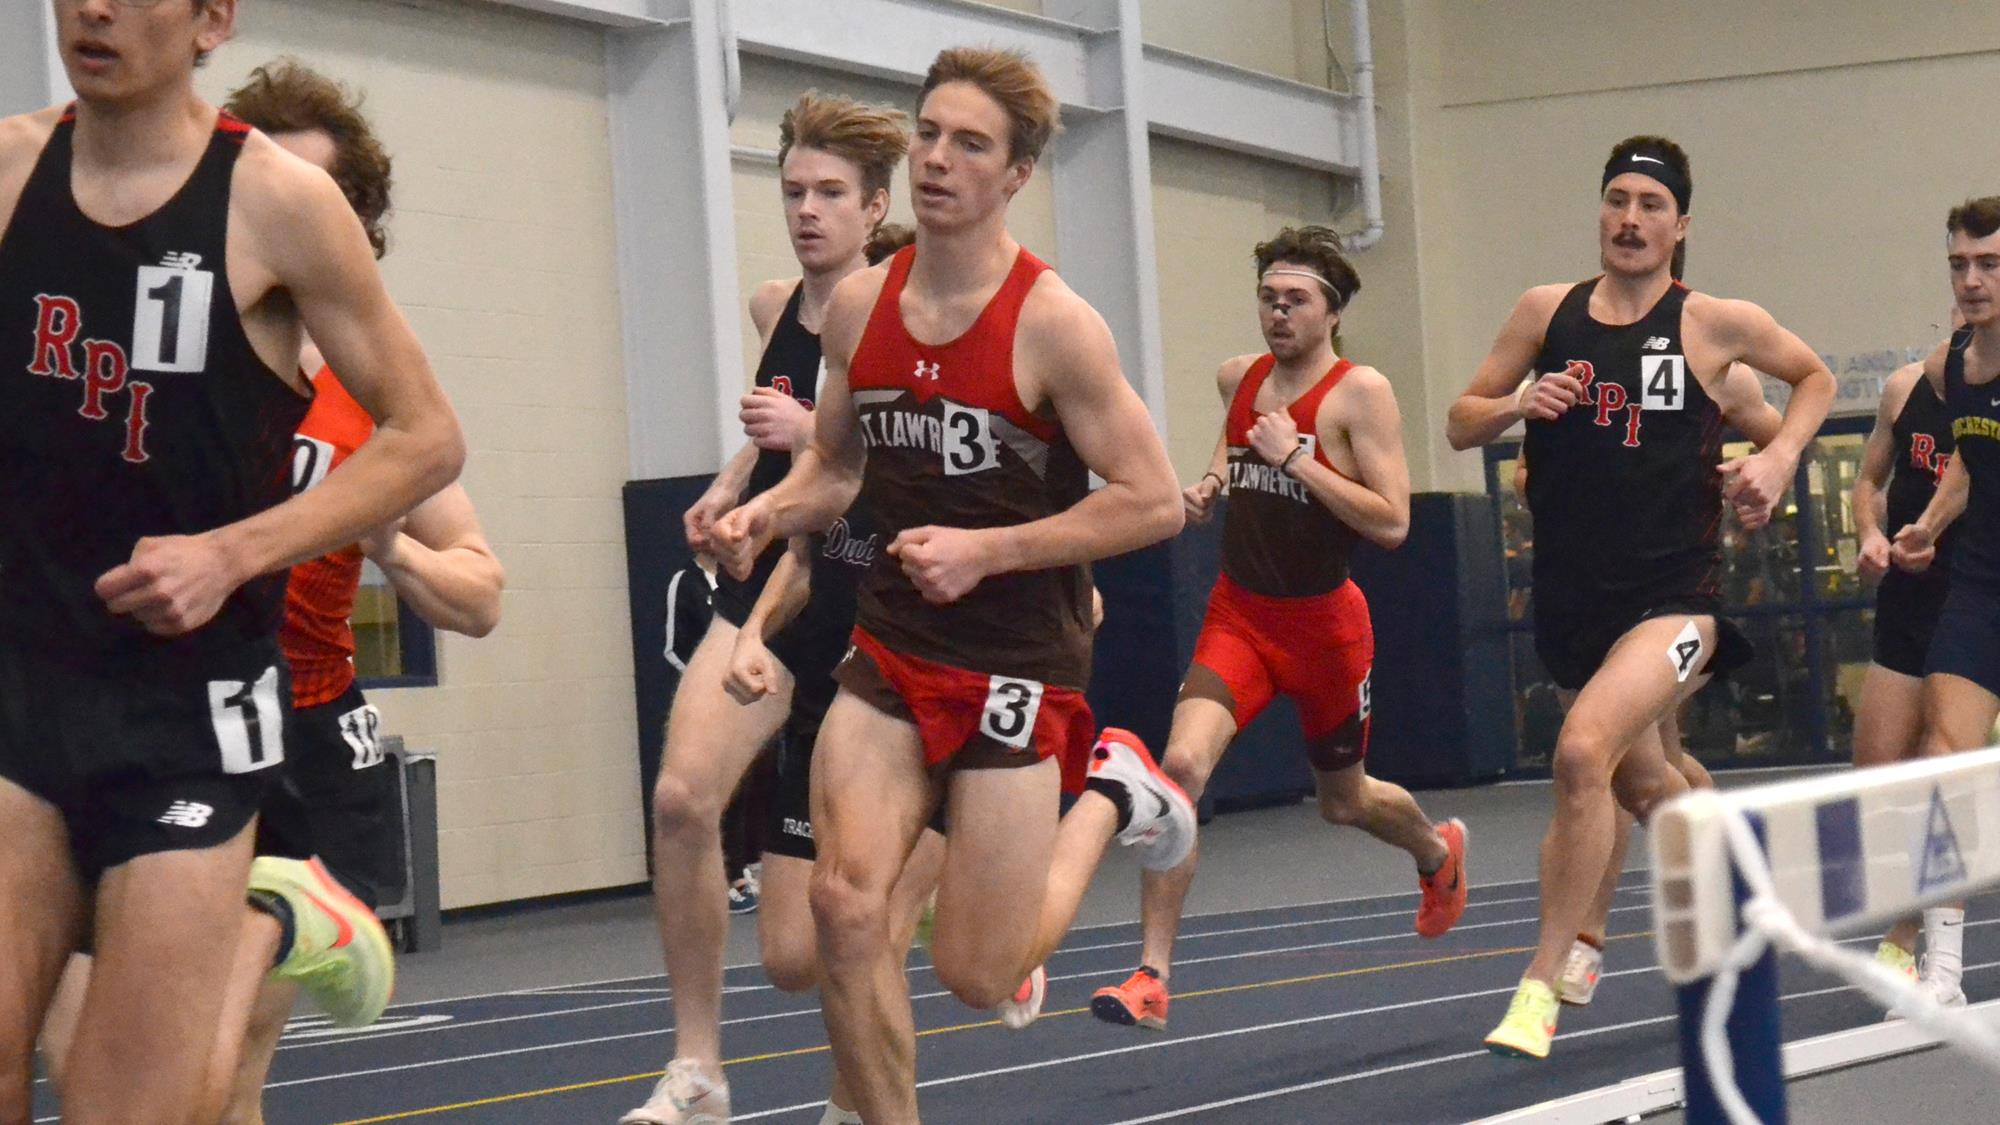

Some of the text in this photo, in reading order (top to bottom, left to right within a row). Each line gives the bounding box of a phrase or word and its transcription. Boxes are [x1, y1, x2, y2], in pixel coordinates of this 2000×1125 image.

[148, 276, 183, 363] 1
[28, 293, 153, 463] RPI
[1647, 359, 1678, 406] 4
[950, 411, 985, 470] 3
[1675, 639, 1700, 674] 4
[224, 683, 263, 764] 1
[989, 682, 1034, 737] 3
[157, 801, 214, 828] NB
